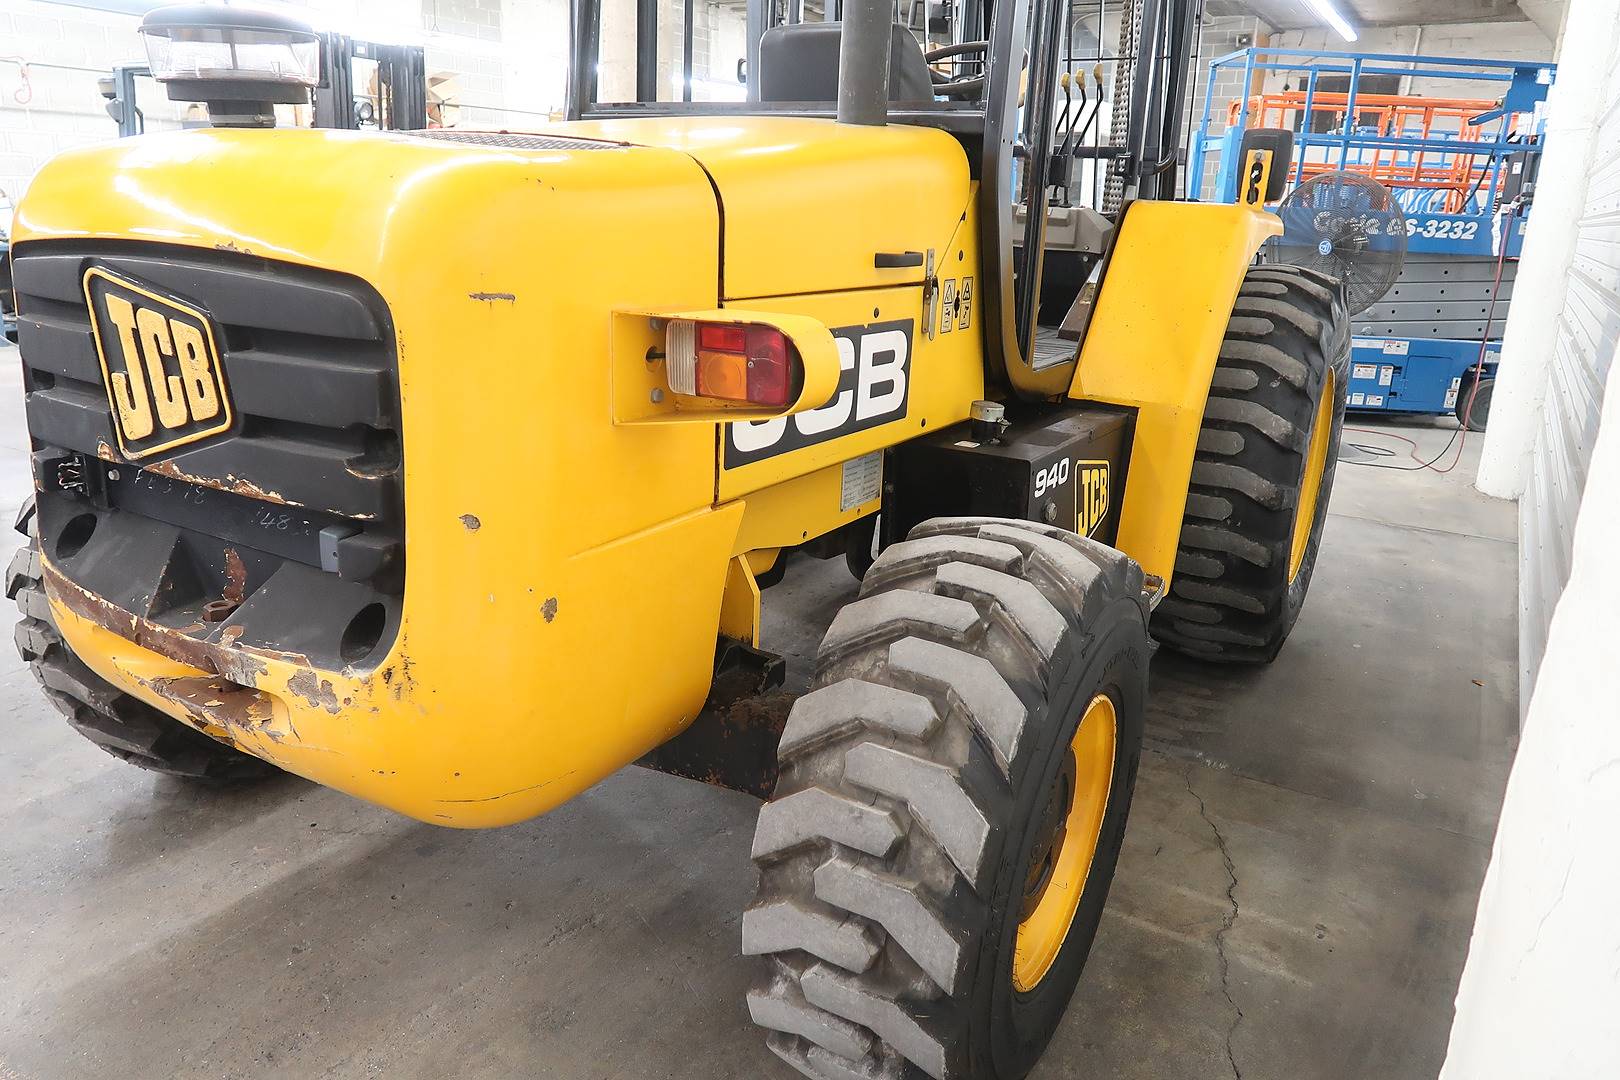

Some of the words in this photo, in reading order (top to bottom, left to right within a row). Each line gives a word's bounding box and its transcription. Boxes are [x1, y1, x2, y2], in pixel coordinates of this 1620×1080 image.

[1386, 217, 1479, 240] GS-3232
[105, 292, 219, 441] JCB
[1034, 457, 1070, 498] 940
[1077, 468, 1108, 538] JCB
